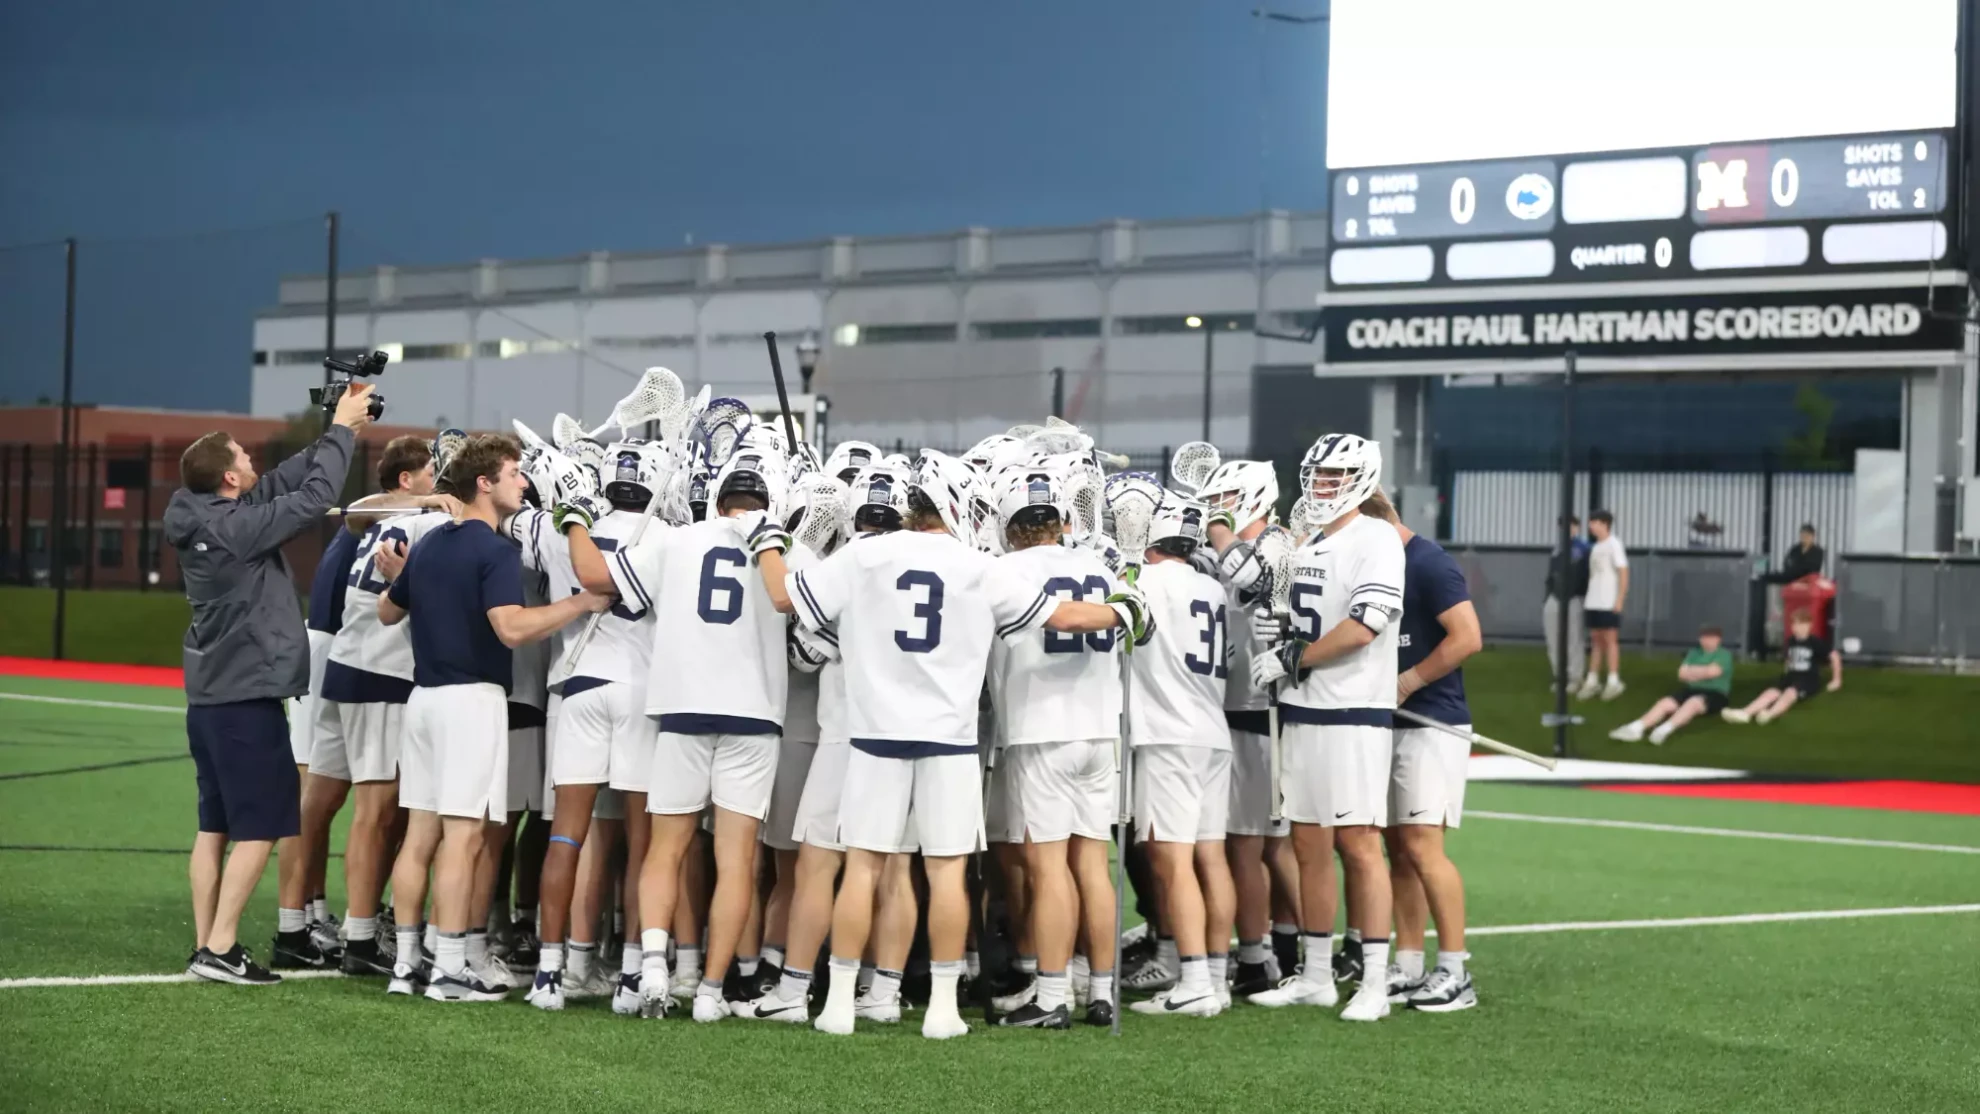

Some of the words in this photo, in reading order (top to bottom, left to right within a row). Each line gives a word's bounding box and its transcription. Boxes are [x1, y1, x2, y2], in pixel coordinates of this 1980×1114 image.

[1844, 143, 1903, 165] SHOTS
[1845, 167, 1903, 188] SAVES
[1450, 177, 1476, 225] 0
[1697, 159, 1748, 210] M
[1771, 158, 1799, 207] 0
[1867, 190, 1902, 210] TOL
[1913, 187, 1926, 209] 2
[1570, 243, 1647, 270] QUARTER
[1655, 237, 1673, 268] 0
[1347, 316, 1448, 349] COACH
[1451, 313, 1530, 346] PAUL
[1533, 309, 1689, 345] HARTMAN
[1693, 302, 1921, 341] SCOREBOARD
[561, 471, 579, 491] 20
[697, 546, 748, 625] 6
[894, 569, 945, 654] 3
[1185, 599, 1228, 679] 31
